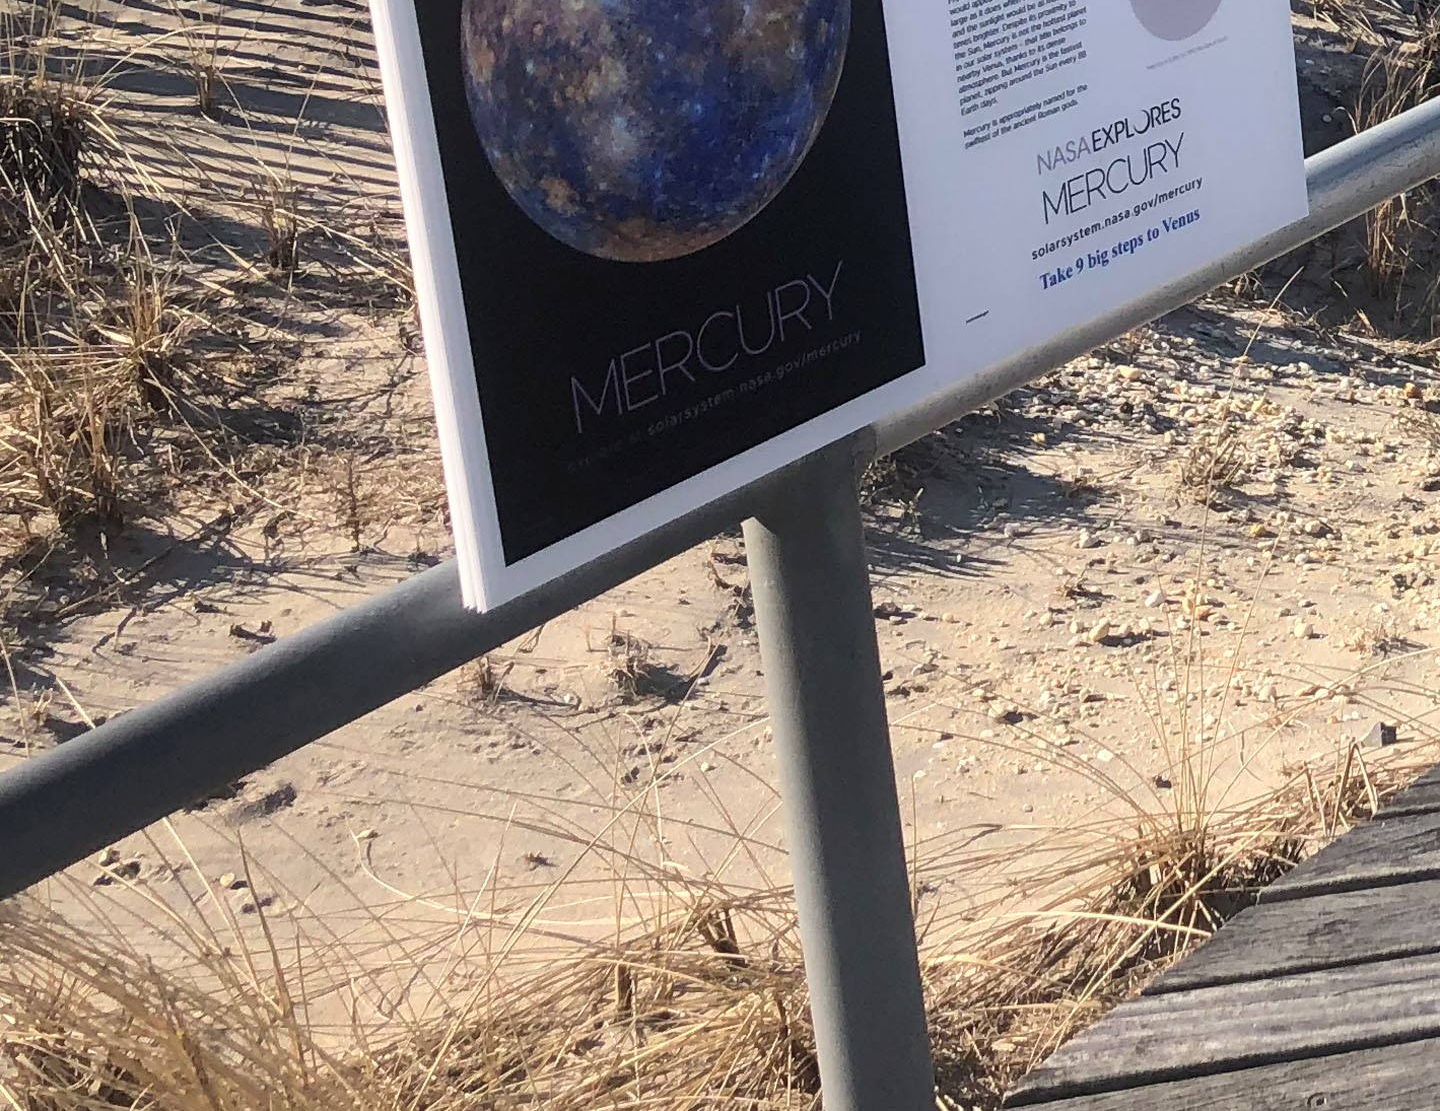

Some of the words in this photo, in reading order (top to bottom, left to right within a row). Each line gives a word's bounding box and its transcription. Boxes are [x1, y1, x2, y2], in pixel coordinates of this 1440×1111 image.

[1031, 177, 1203, 260] solarsystem.nasa.gov/mercury
[1042, 132, 1185, 224] MERCURY
[1039, 267, 1074, 290] Take
[1075, 257, 1085, 274] 9
[1087, 250, 1110, 268] big
[1111, 235, 1144, 259] steps
[1146, 228, 1160, 241] to
[1162, 208, 1200, 233] Venus
[570, 259, 844, 434] MERCURY
